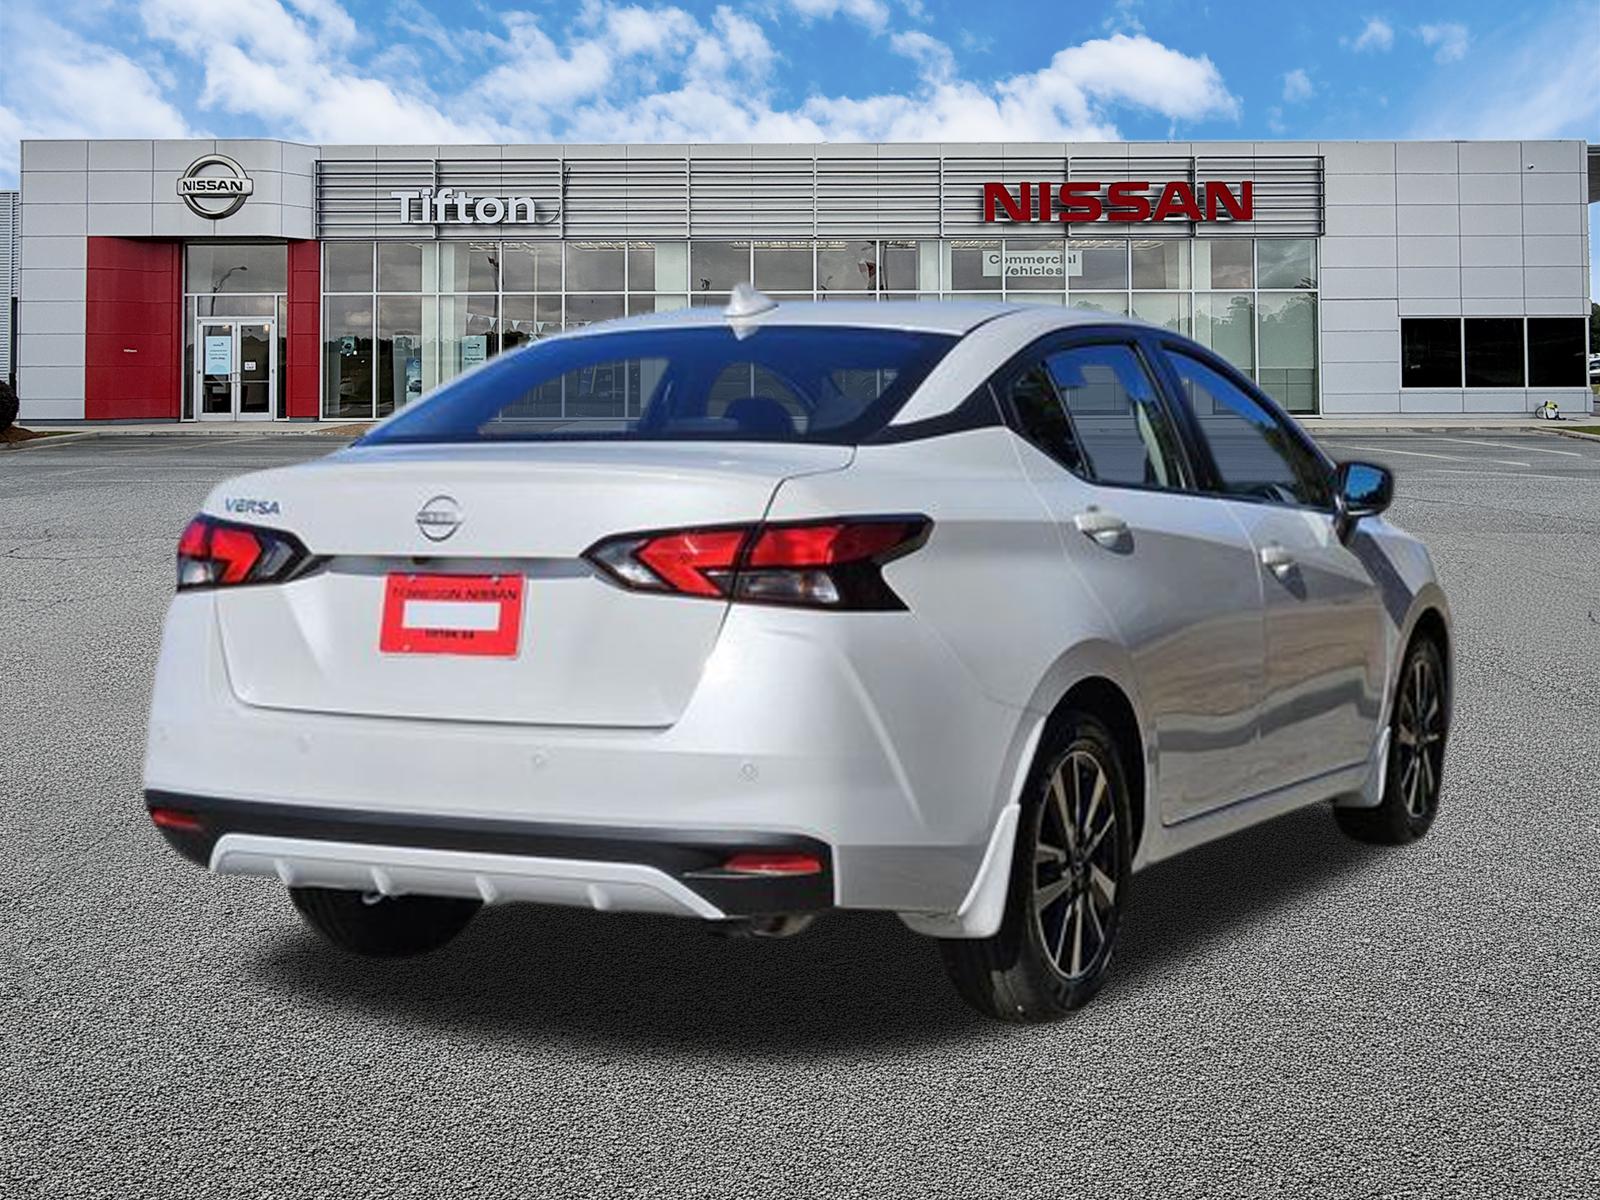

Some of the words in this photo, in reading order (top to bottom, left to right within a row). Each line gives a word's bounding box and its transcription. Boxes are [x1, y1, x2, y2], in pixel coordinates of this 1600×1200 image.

[182, 180, 243, 191] NISSAN
[391, 187, 536, 224] Tifton
[984, 180, 1253, 223] NISSAN
[989, 254, 1077, 264] Cmmercil
[225, 498, 280, 514] VERSA
